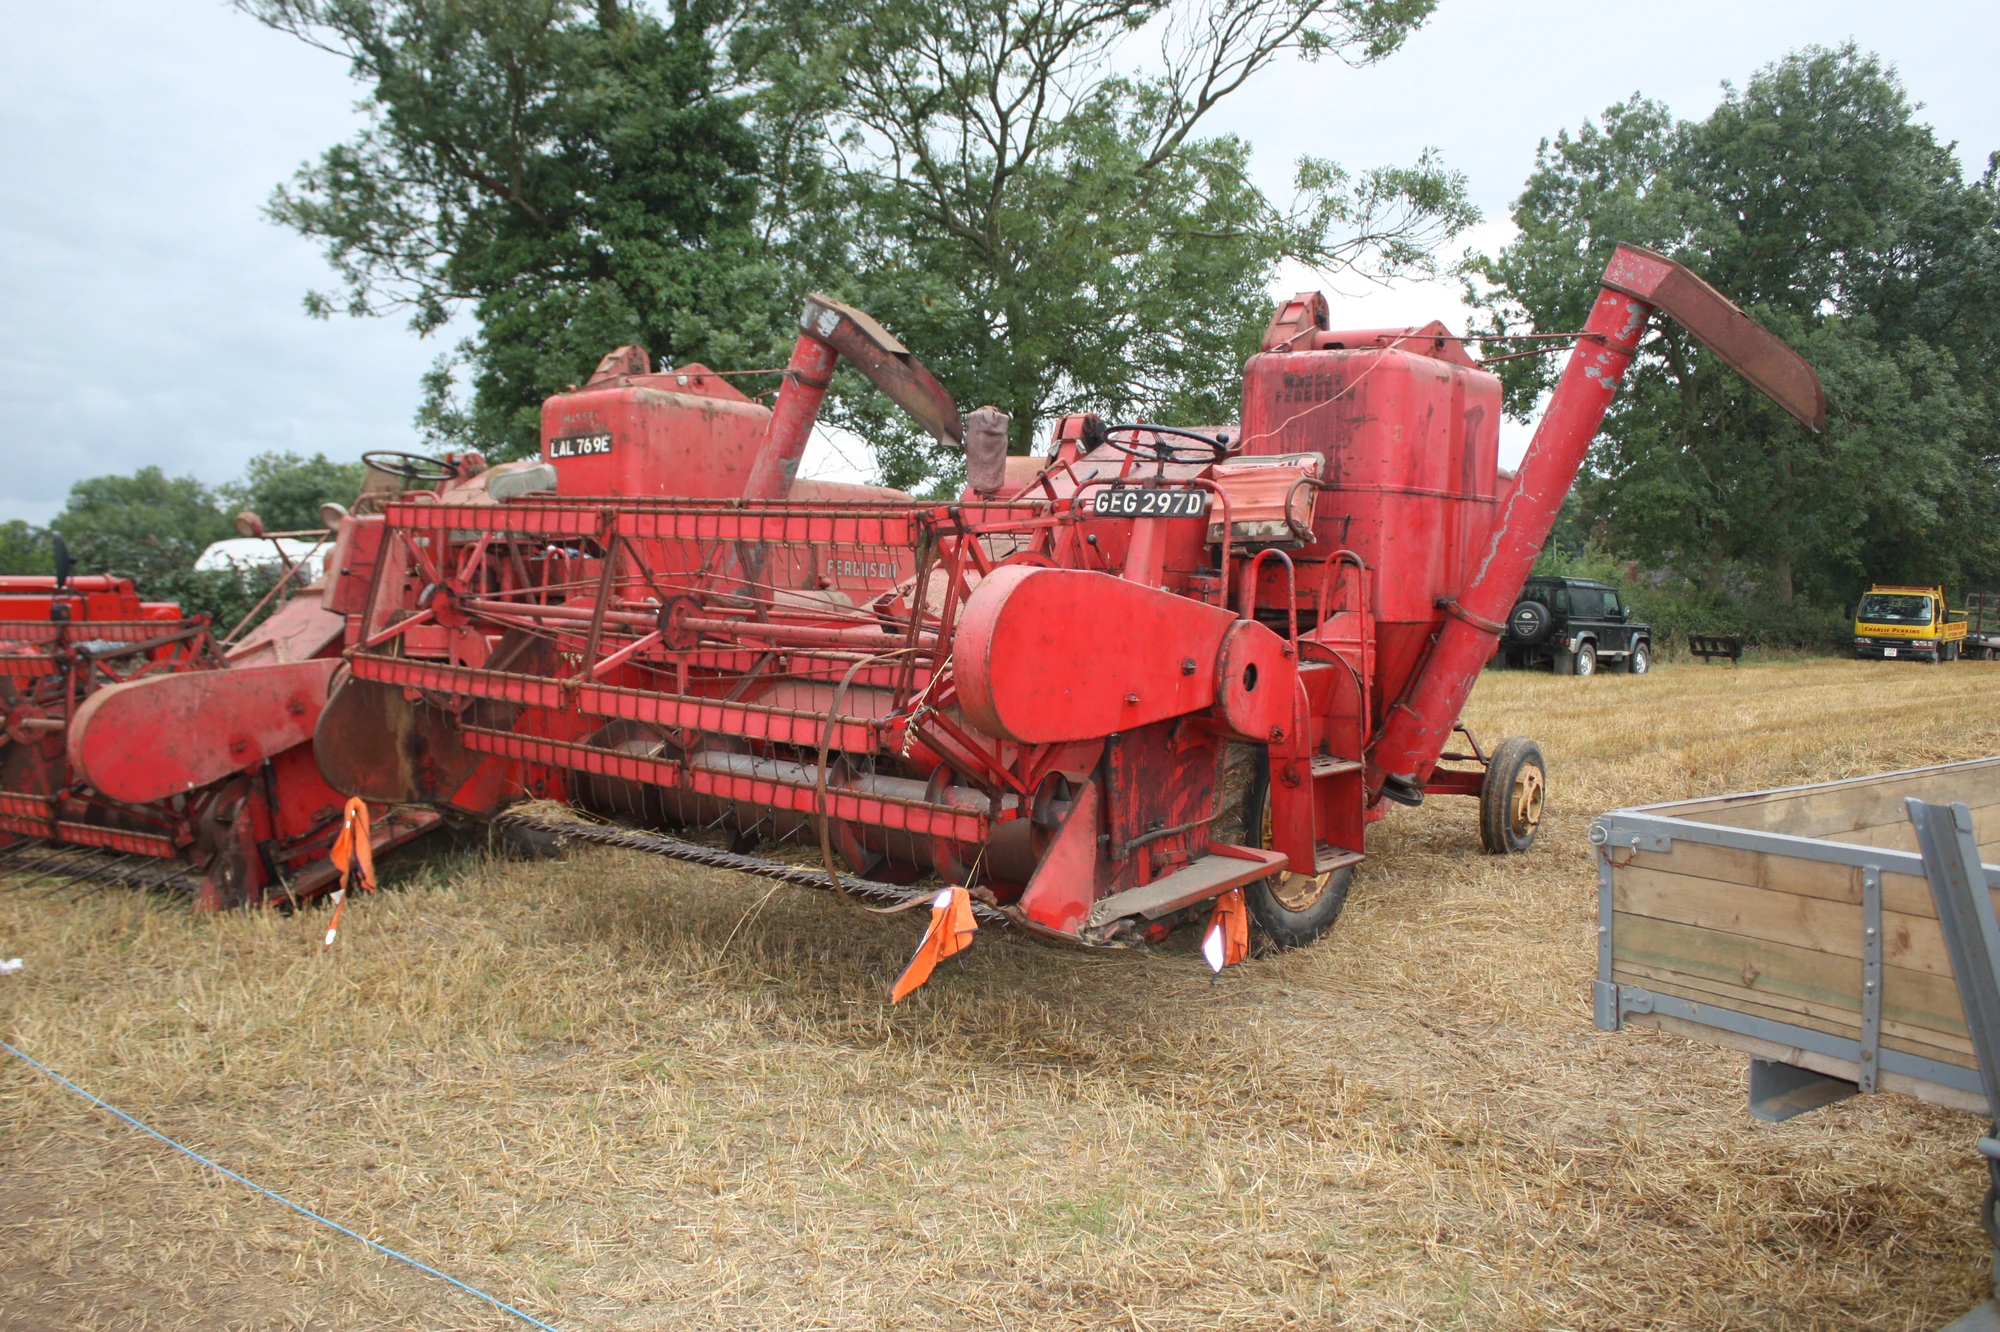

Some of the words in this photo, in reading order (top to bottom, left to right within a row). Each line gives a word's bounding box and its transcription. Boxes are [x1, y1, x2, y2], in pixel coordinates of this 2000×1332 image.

[550, 440, 575, 457] LAL
[576, 436, 609, 454] 769E
[1095, 493, 1138, 514] GEG
[1141, 492, 1201, 514] 297D
[827, 560, 897, 578] FERGUSON
